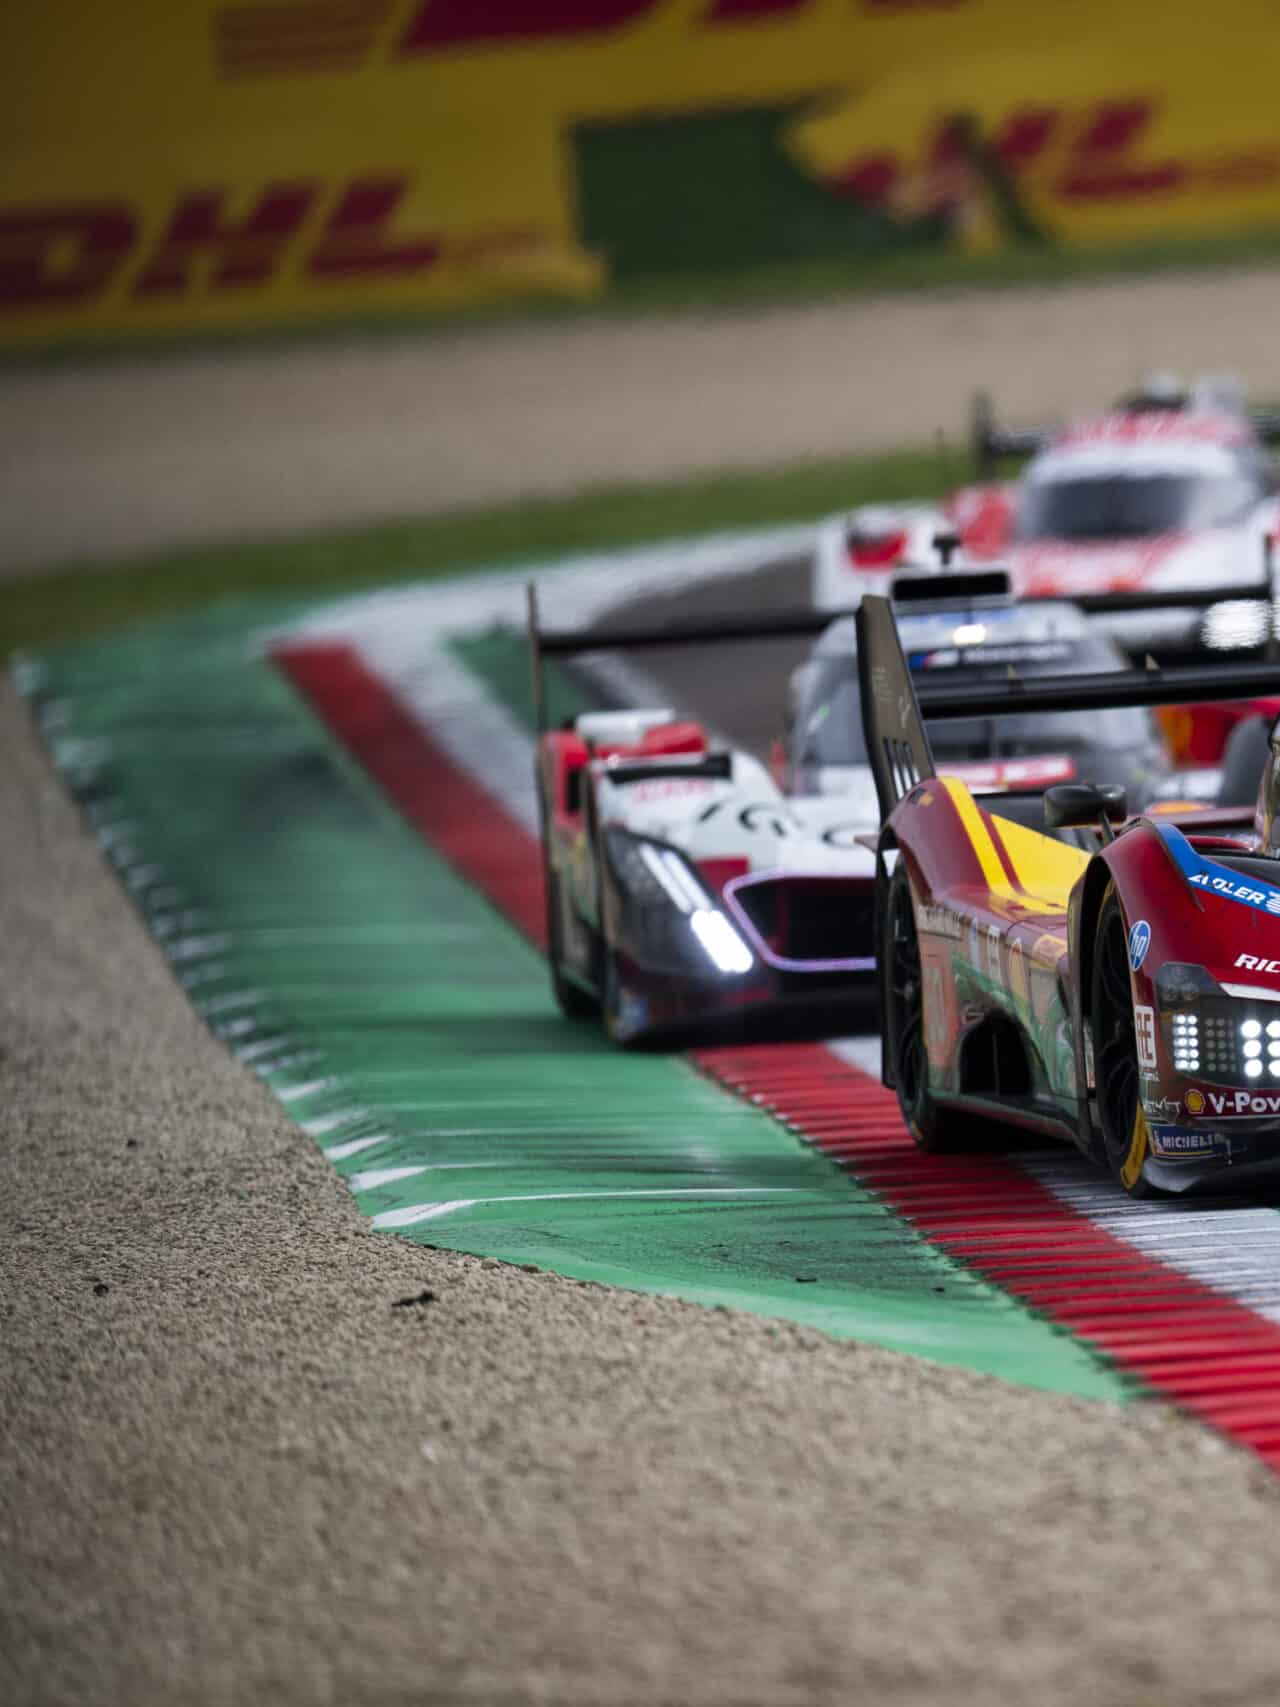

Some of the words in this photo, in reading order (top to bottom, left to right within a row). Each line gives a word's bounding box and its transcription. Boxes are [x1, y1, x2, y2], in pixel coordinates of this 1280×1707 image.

[0, 168, 440, 308] DHL
[1188, 872, 1261, 904] ADLER
[1131, 926, 1149, 966] hp
